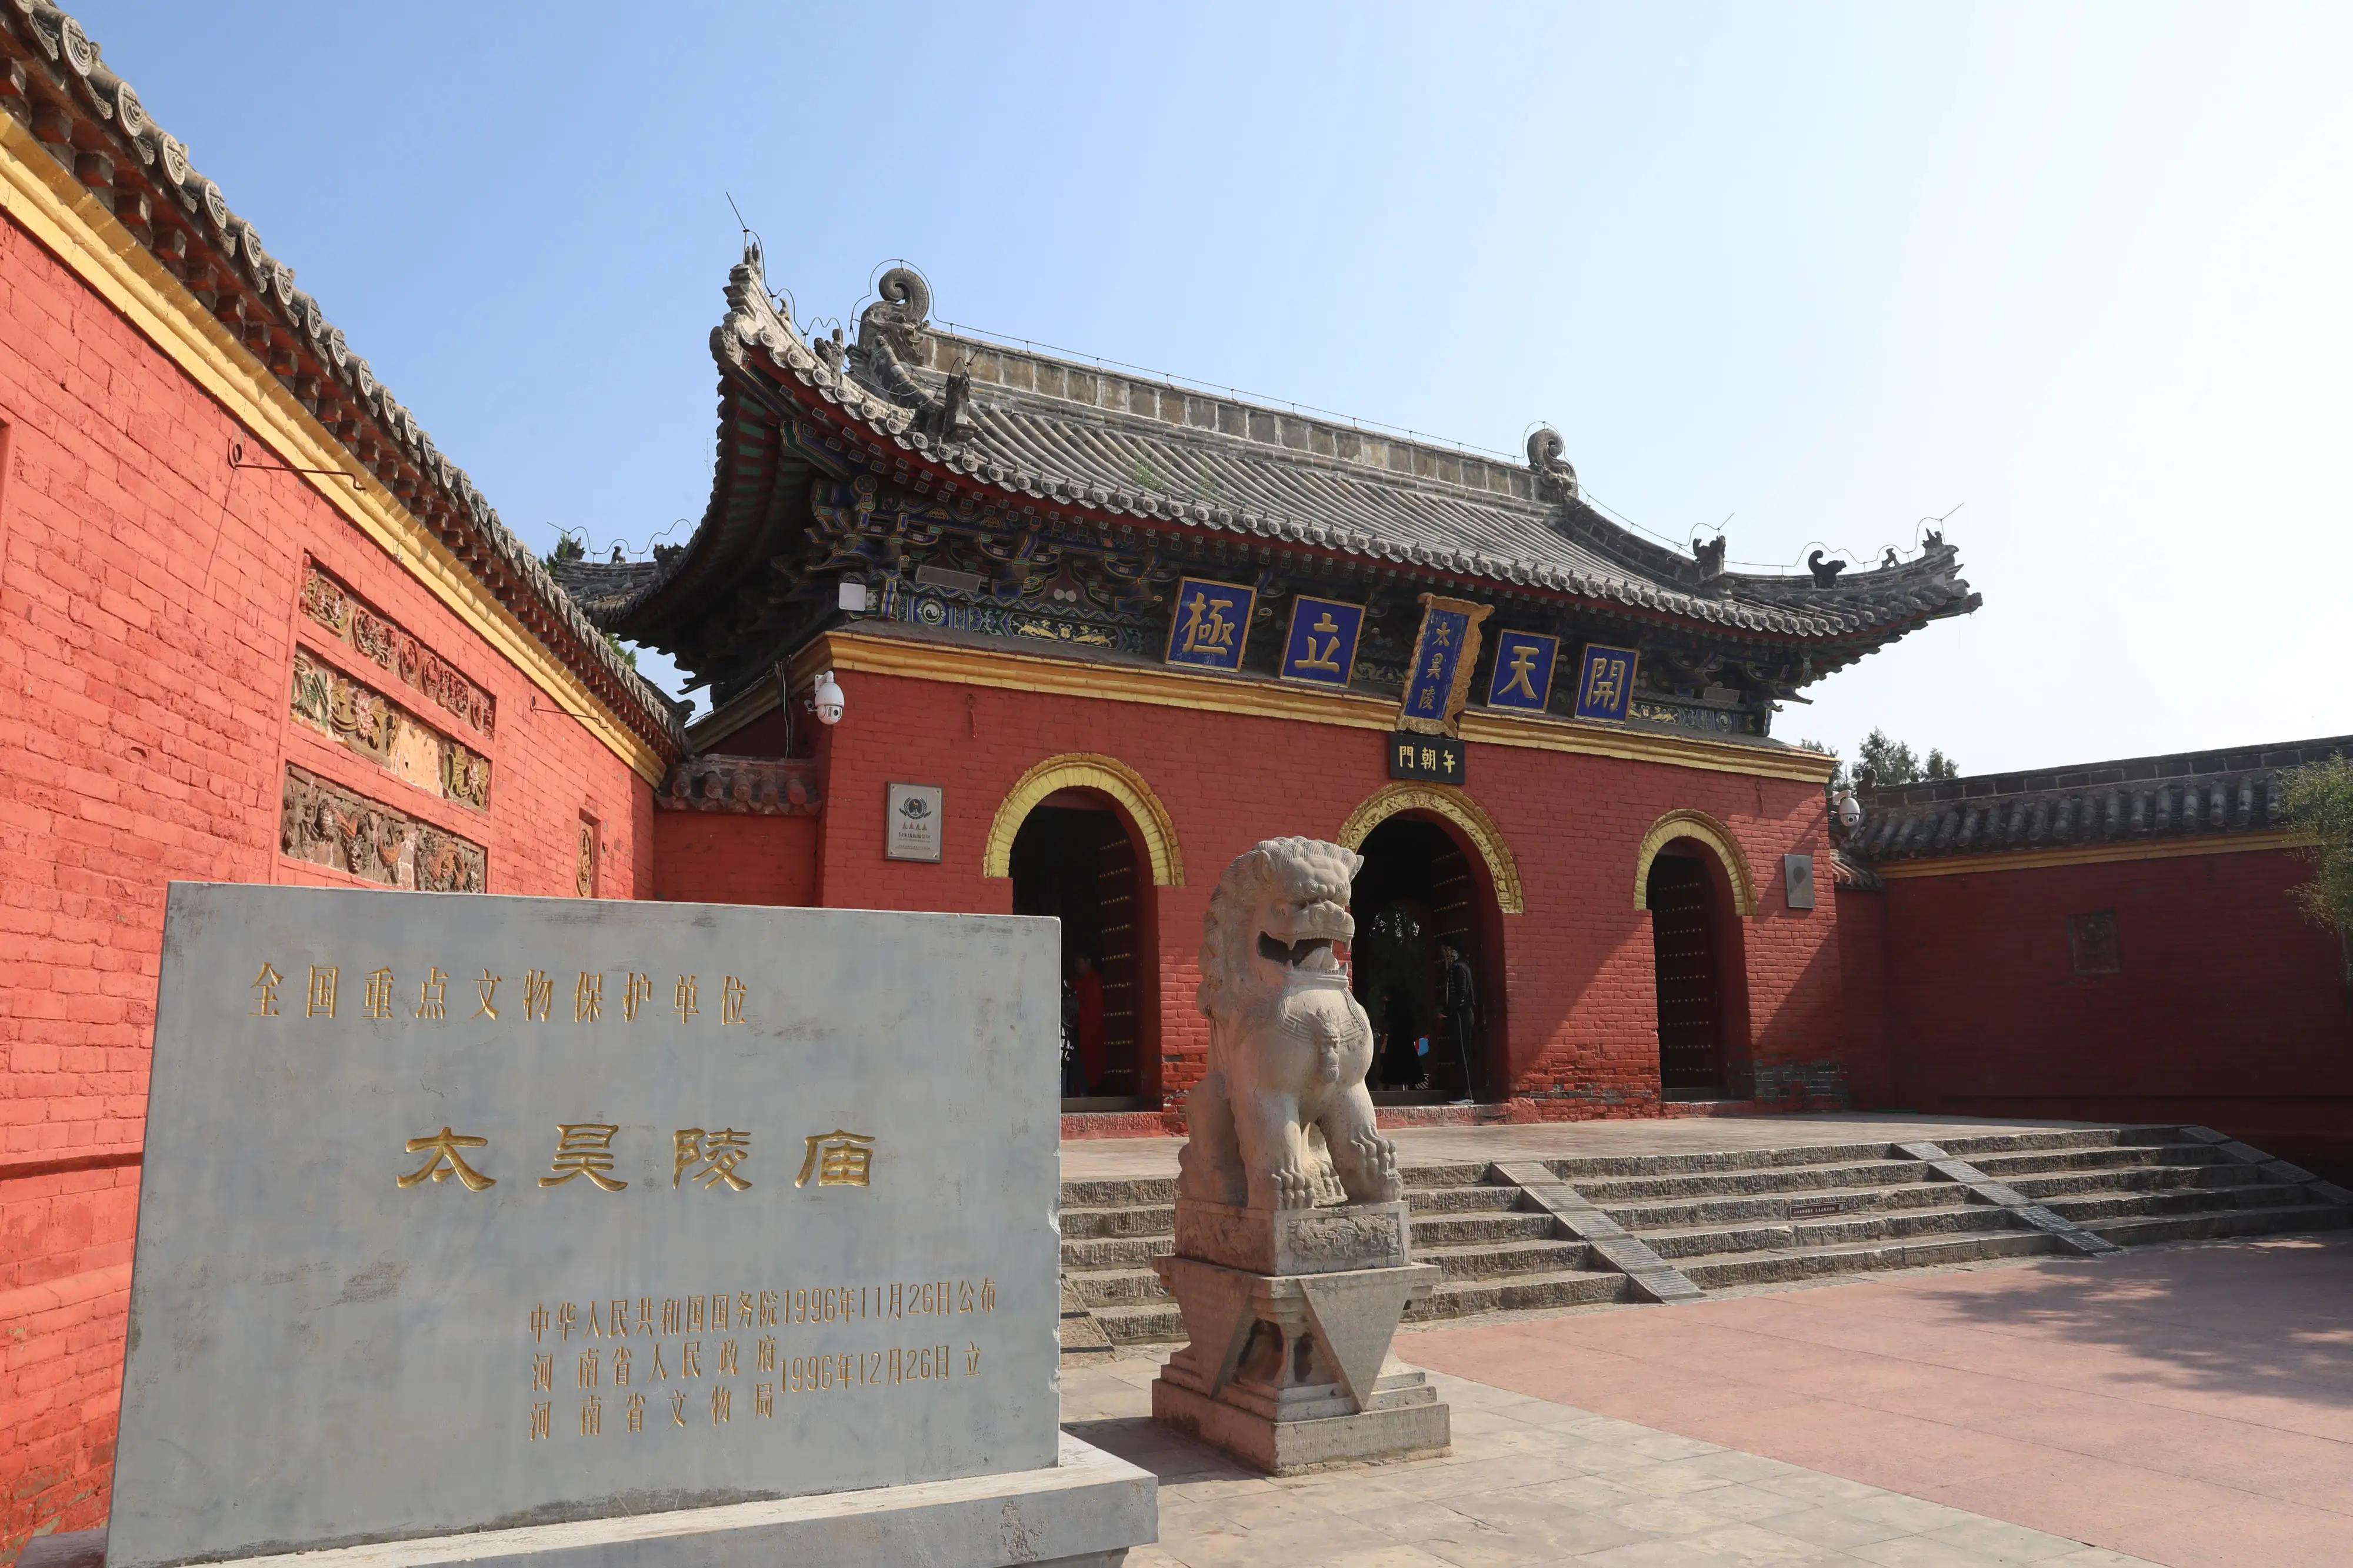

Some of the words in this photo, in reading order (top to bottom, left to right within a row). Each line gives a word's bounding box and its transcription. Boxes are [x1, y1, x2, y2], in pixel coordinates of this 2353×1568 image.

[1181, 592, 1235, 657] 極
[1295, 612, 1341, 673] 立
[1497, 646, 1540, 700] 天
[1585, 657, 1627, 711] 開
[248, 962, 749, 1026] 全国重点文物保护单位
[396, 1123, 876, 1193] 太昊陵庙
[529, 1276, 996, 1344] 中华人民共和国国务院1996年11月26日公布
[532, 1334, 776, 1393] 河南省人民政府
[530, 1383, 773, 1442] 河南省文物局
